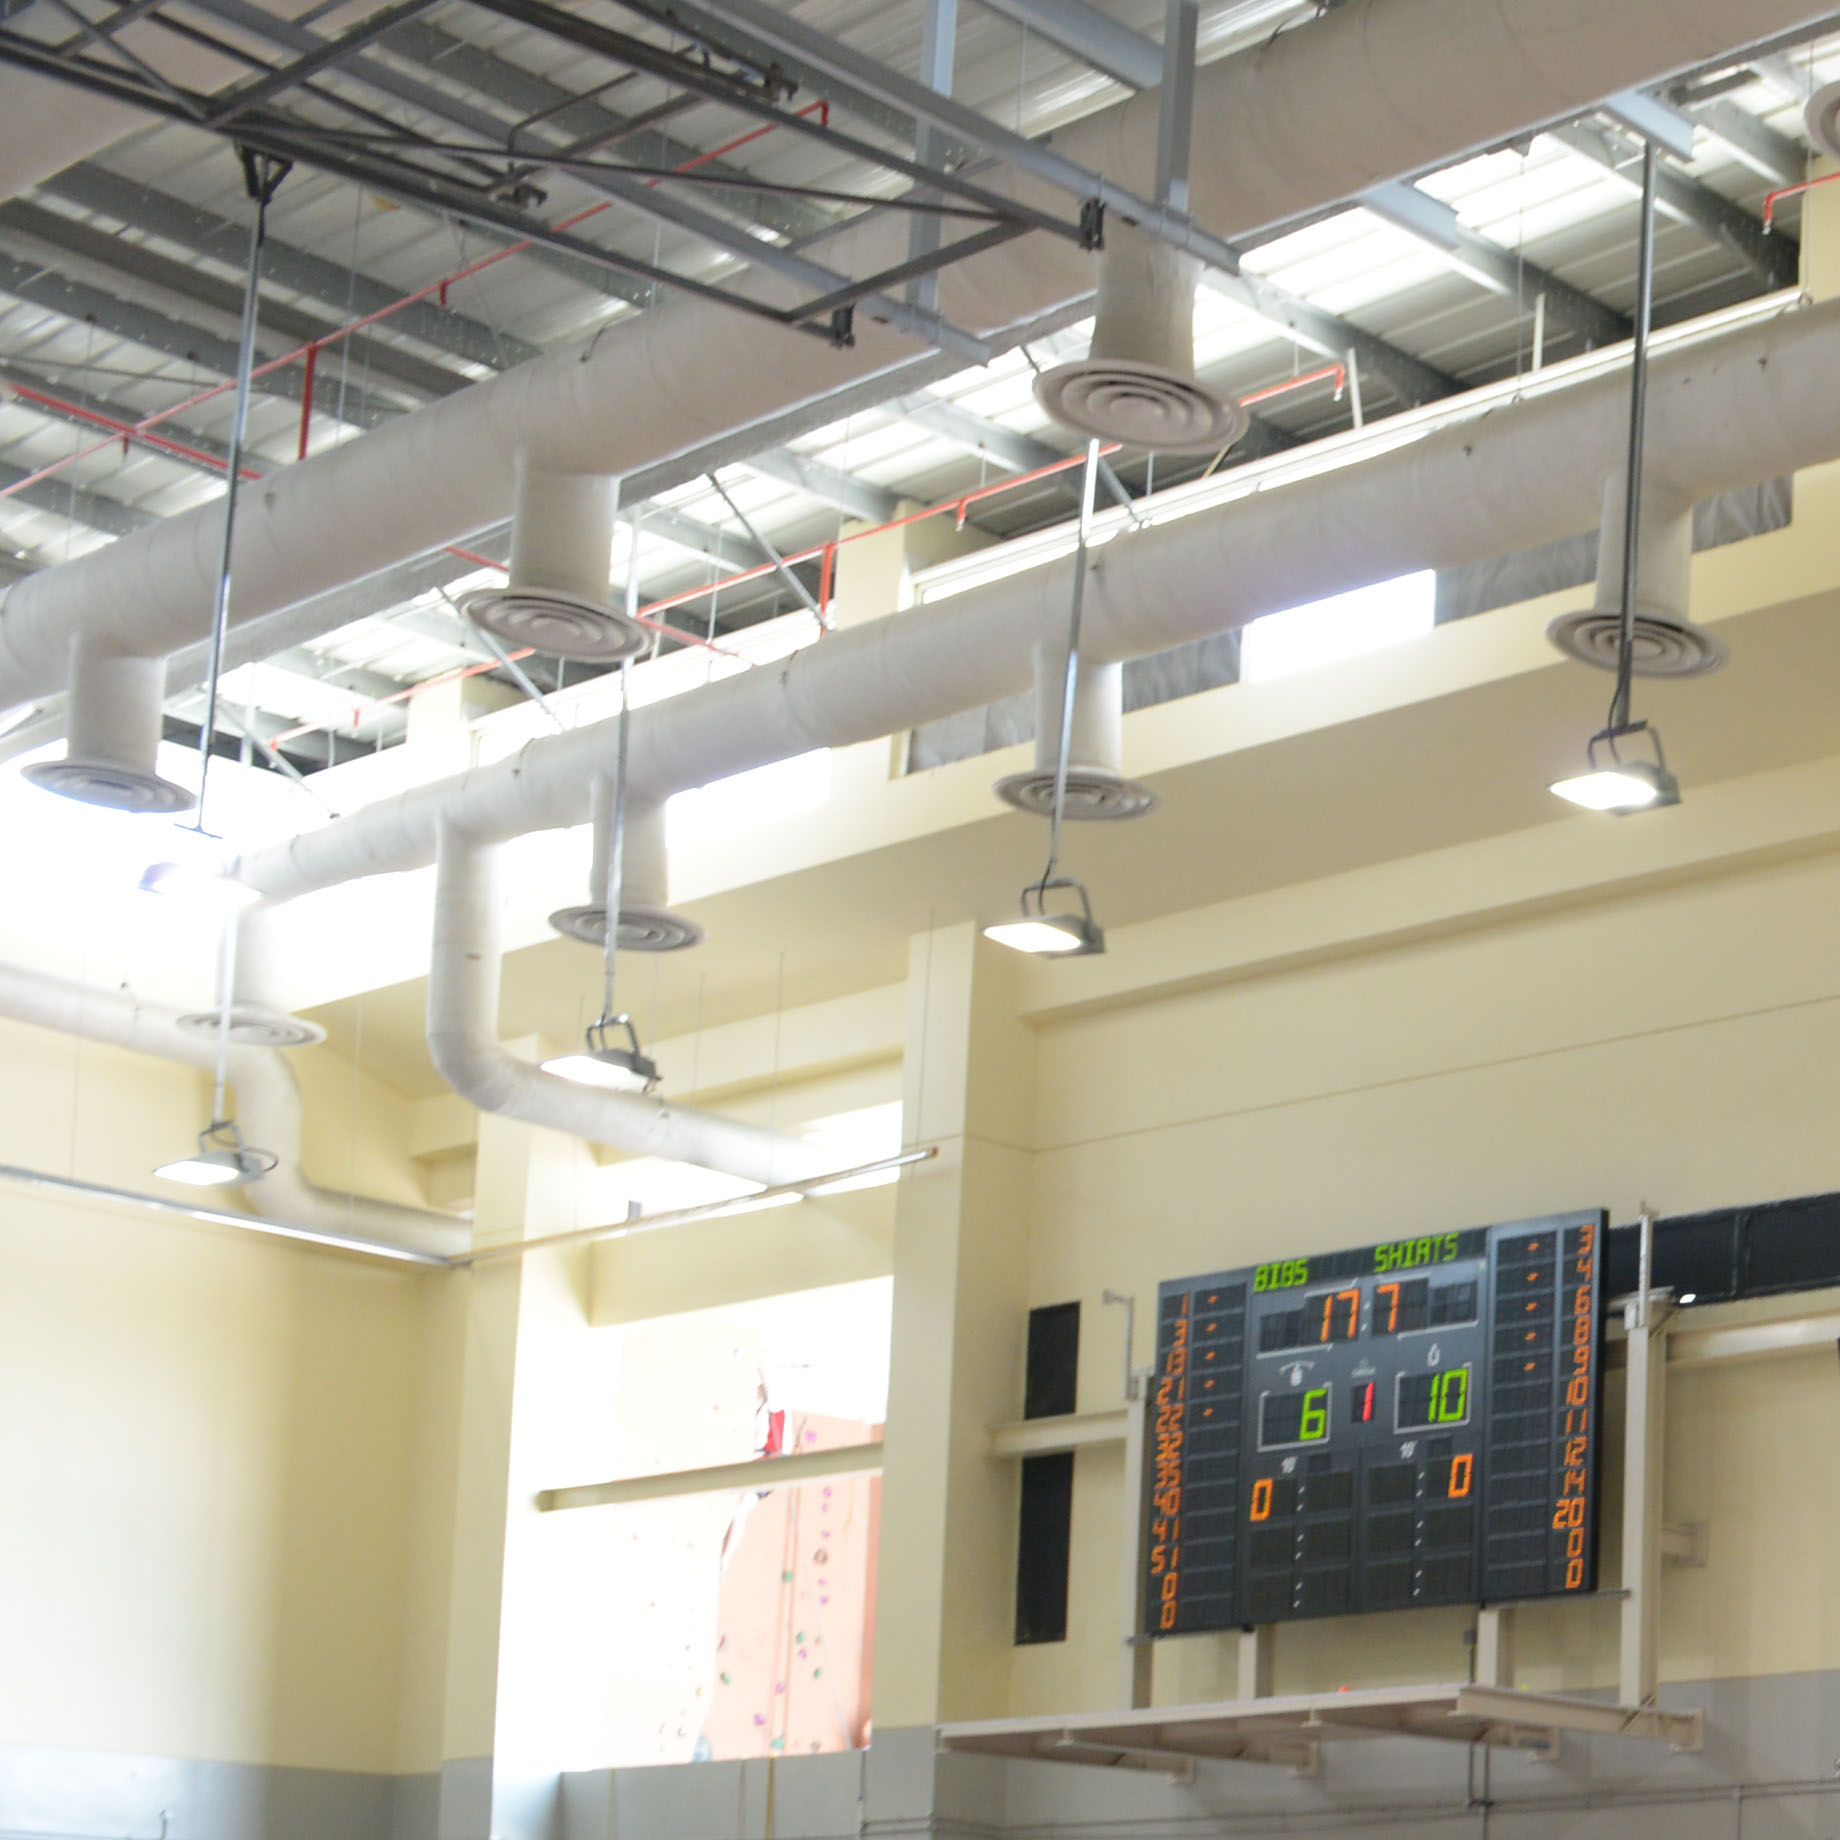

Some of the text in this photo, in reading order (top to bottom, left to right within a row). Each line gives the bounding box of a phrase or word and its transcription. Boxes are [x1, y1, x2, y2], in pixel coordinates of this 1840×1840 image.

[1373, 1232, 1460, 1273] SHIRTS
[1578, 1224, 1594, 1255] 3
[1253, 1257, 1309, 1293] BIBS
[1576, 1256, 1592, 1281] 4
[1575, 1284, 1591, 1315] 6
[1573, 1314, 1591, 1345] 8
[1573, 1344, 1590, 1375] 9
[1362, 1381, 1375, 1423] 1
[1427, 1368, 1468, 1423] 10
[1566, 1375, 1589, 1406] 10
[1299, 1387, 1328, 1441] 6
[1448, 1453, 1474, 1498] 0
[1250, 1479, 1274, 1522] 0
[1552, 1497, 1586, 1530] 20
[1566, 1527, 1584, 1558] 0
[1565, 1558, 1584, 1589] 0
